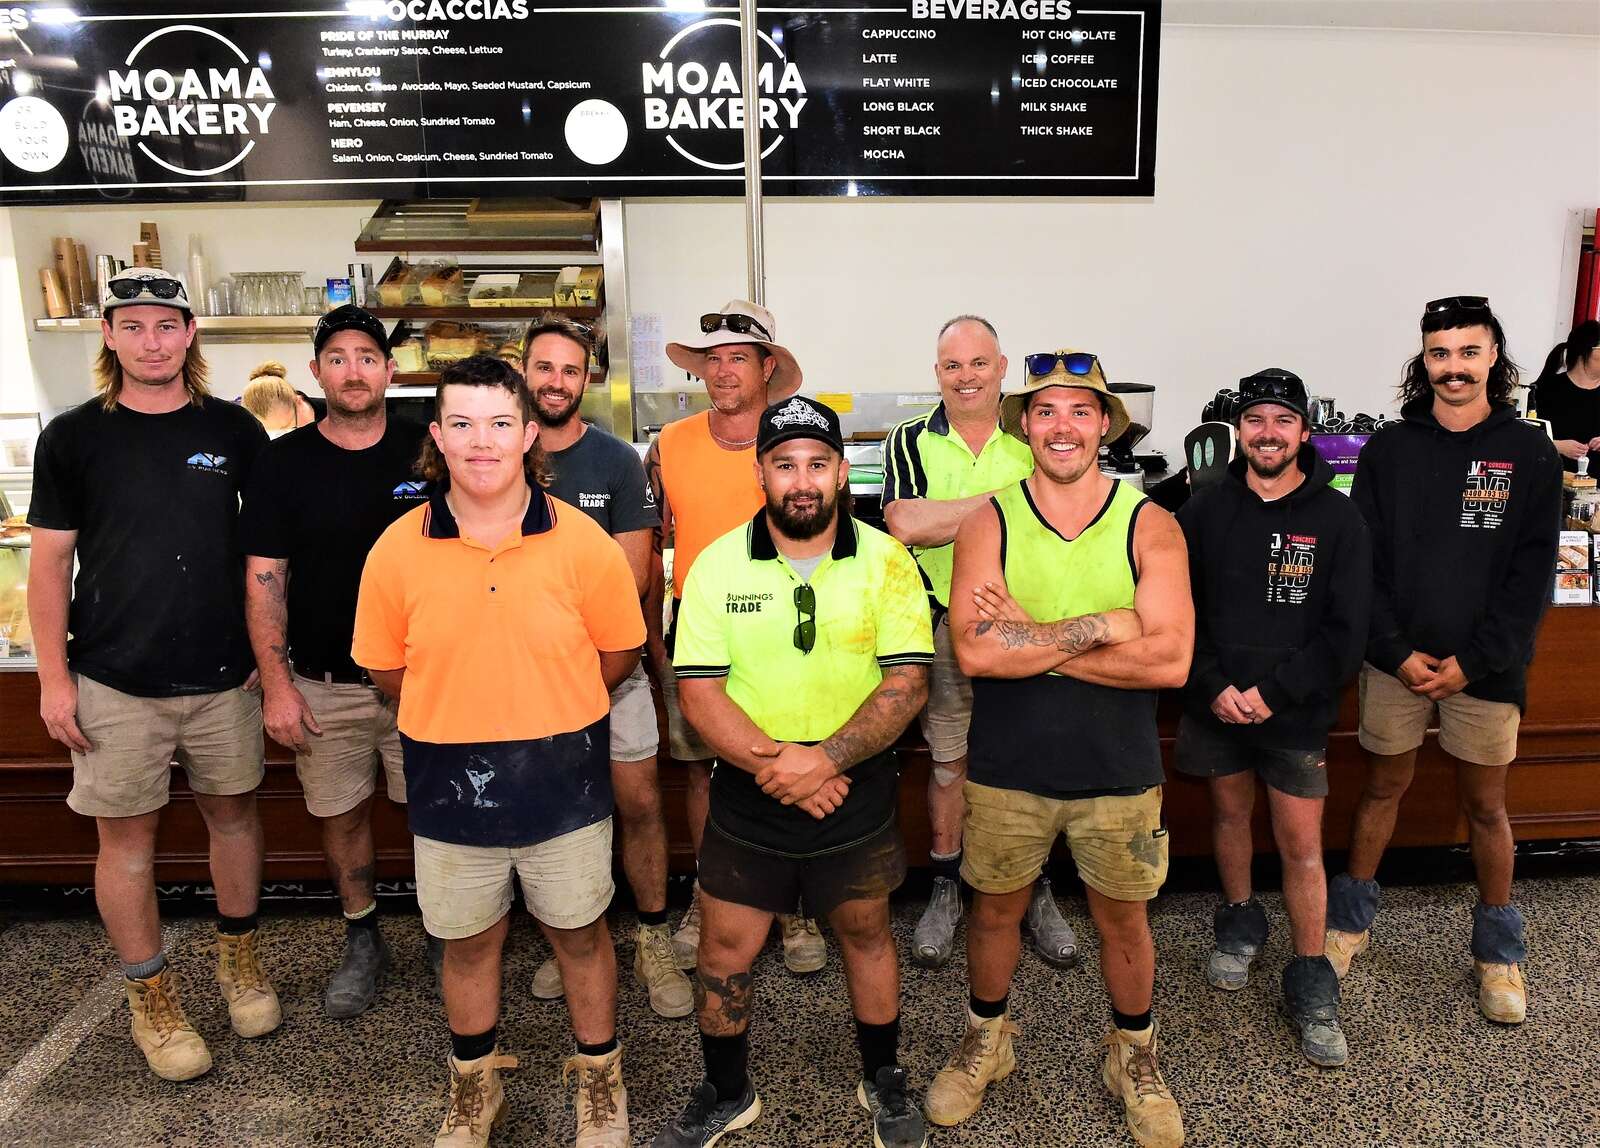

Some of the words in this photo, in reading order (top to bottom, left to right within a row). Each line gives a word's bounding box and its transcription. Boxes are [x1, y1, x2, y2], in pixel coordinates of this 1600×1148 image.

[368, 0, 529, 21] OCACCIAS
[911, 0, 1073, 21] BEVERAGES
[321, 31, 356, 41] PRIDE
[357, 30, 374, 41] OF
[376, 30, 400, 41] THE
[401, 29, 450, 40] MURRAY
[862, 29, 937, 39] CAPPUCCINO
[1022, 30, 1046, 40] HOT
[1048, 30, 1117, 40] CHOCOLATE
[322, 47, 353, 57] Turkey,
[355, 46, 399, 56] Cranberry
[401, 46, 431, 55] Sauce,
[432, 46, 467, 55] Cheese,
[468, 45, 504, 55] Lettuce
[862, 53, 898, 64] LATTE
[1022, 54, 1048, 64] ICED
[1050, 54, 1095, 65] COFFEE
[325, 66, 381, 78] EMMYLOU
[108, 67, 275, 101] MOAMA
[325, 83, 364, 93] Chicken,
[364, 82, 397, 92] Cheese
[400, 81, 442, 91] Avocado,
[443, 81, 470, 91] Mayo,
[471, 81, 506, 90] Seeded
[507, 80, 546, 90] Mustard,
[547, 80, 591, 90] Capsicum
[862, 78, 893, 88] FLAT
[893, 78, 931, 88] WHITE
[1021, 79, 1048, 88] ICED
[1050, 78, 1118, 89] CHOCOLATE
[327, 103, 387, 114] PEVENSEY
[863, 101, 895, 112] LONG
[897, 102, 935, 112] BLACK
[1020, 102, 1047, 112] MILK
[1050, 102, 1087, 112] SHAKE
[644, 97, 808, 129] BAKERY
[114, 103, 276, 136] BAKERY
[329, 119, 352, 128] Ham,
[353, 118, 389, 128] Cheese,
[389, 117, 419, 127] Onion,
[420, 117, 461, 126] Sundried
[462, 117, 496, 126] Tomato
[863, 125, 901, 136] SHORT
[903, 126, 941, 136] BLACK
[1020, 126, 1054, 136] THICK
[1056, 126, 1093, 136] SHAKE
[330, 138, 364, 149] HERO
[332, 154, 364, 163] Salami,
[365, 154, 395, 163] Onion,
[396, 153, 441, 162] Capsicum,
[442, 152, 478, 161] Cheese,
[479, 152, 519, 161] Sundried
[520, 151, 553, 160] Tomato
[863, 149, 905, 159] MOCHA
[579, 499, 605, 508] TRADE
[726, 592, 774, 602] BUNNINGS
[725, 601, 762, 614] TRADE
